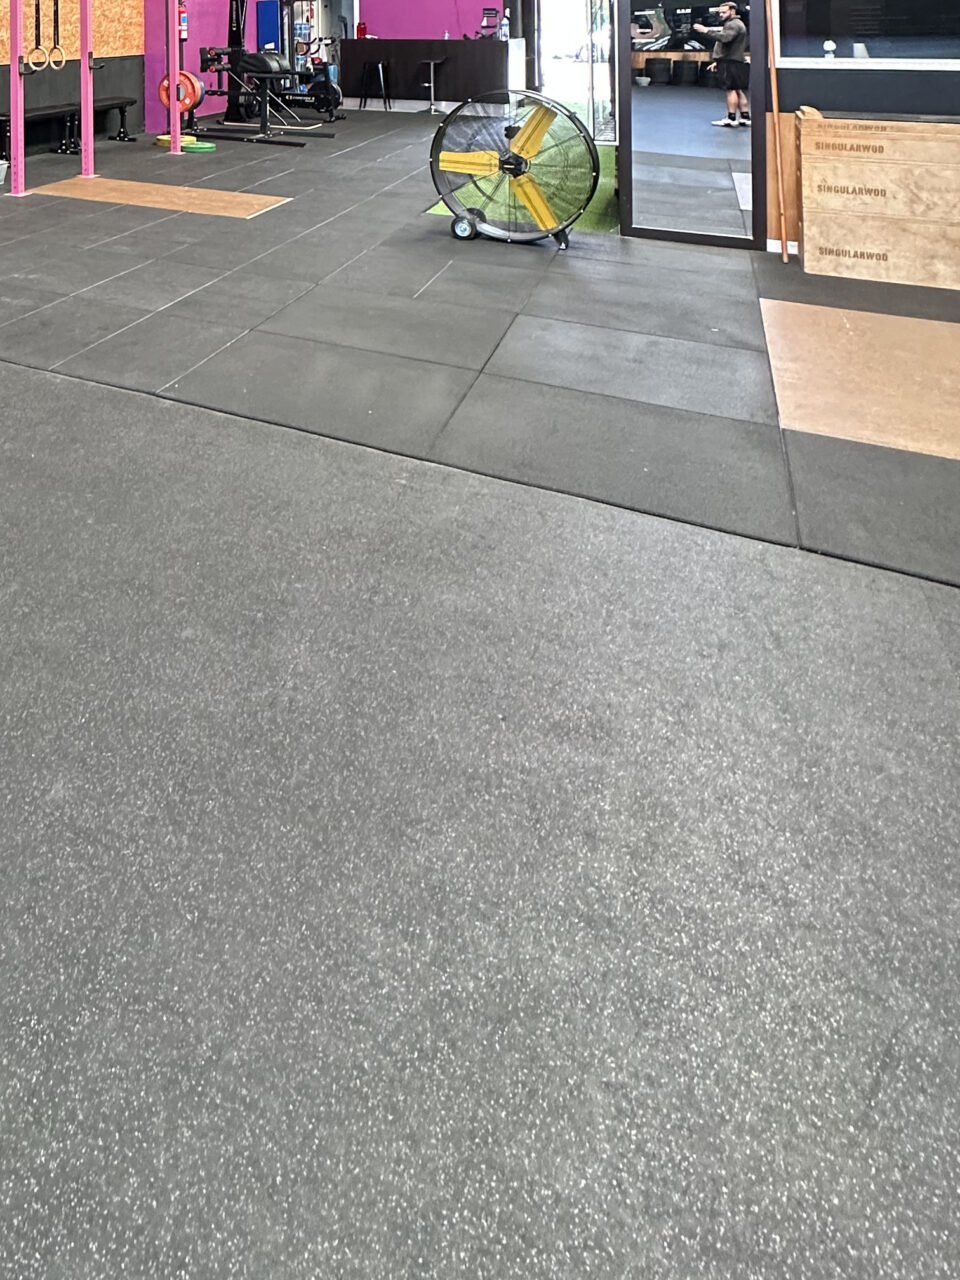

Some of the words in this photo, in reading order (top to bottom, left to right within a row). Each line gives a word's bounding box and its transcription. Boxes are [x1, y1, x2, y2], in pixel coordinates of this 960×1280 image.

[815, 142, 884, 154] SINGULARWOD
[817, 184, 887, 197] SINGULARWOD
[818, 247, 889, 262] SINGULARWOD
